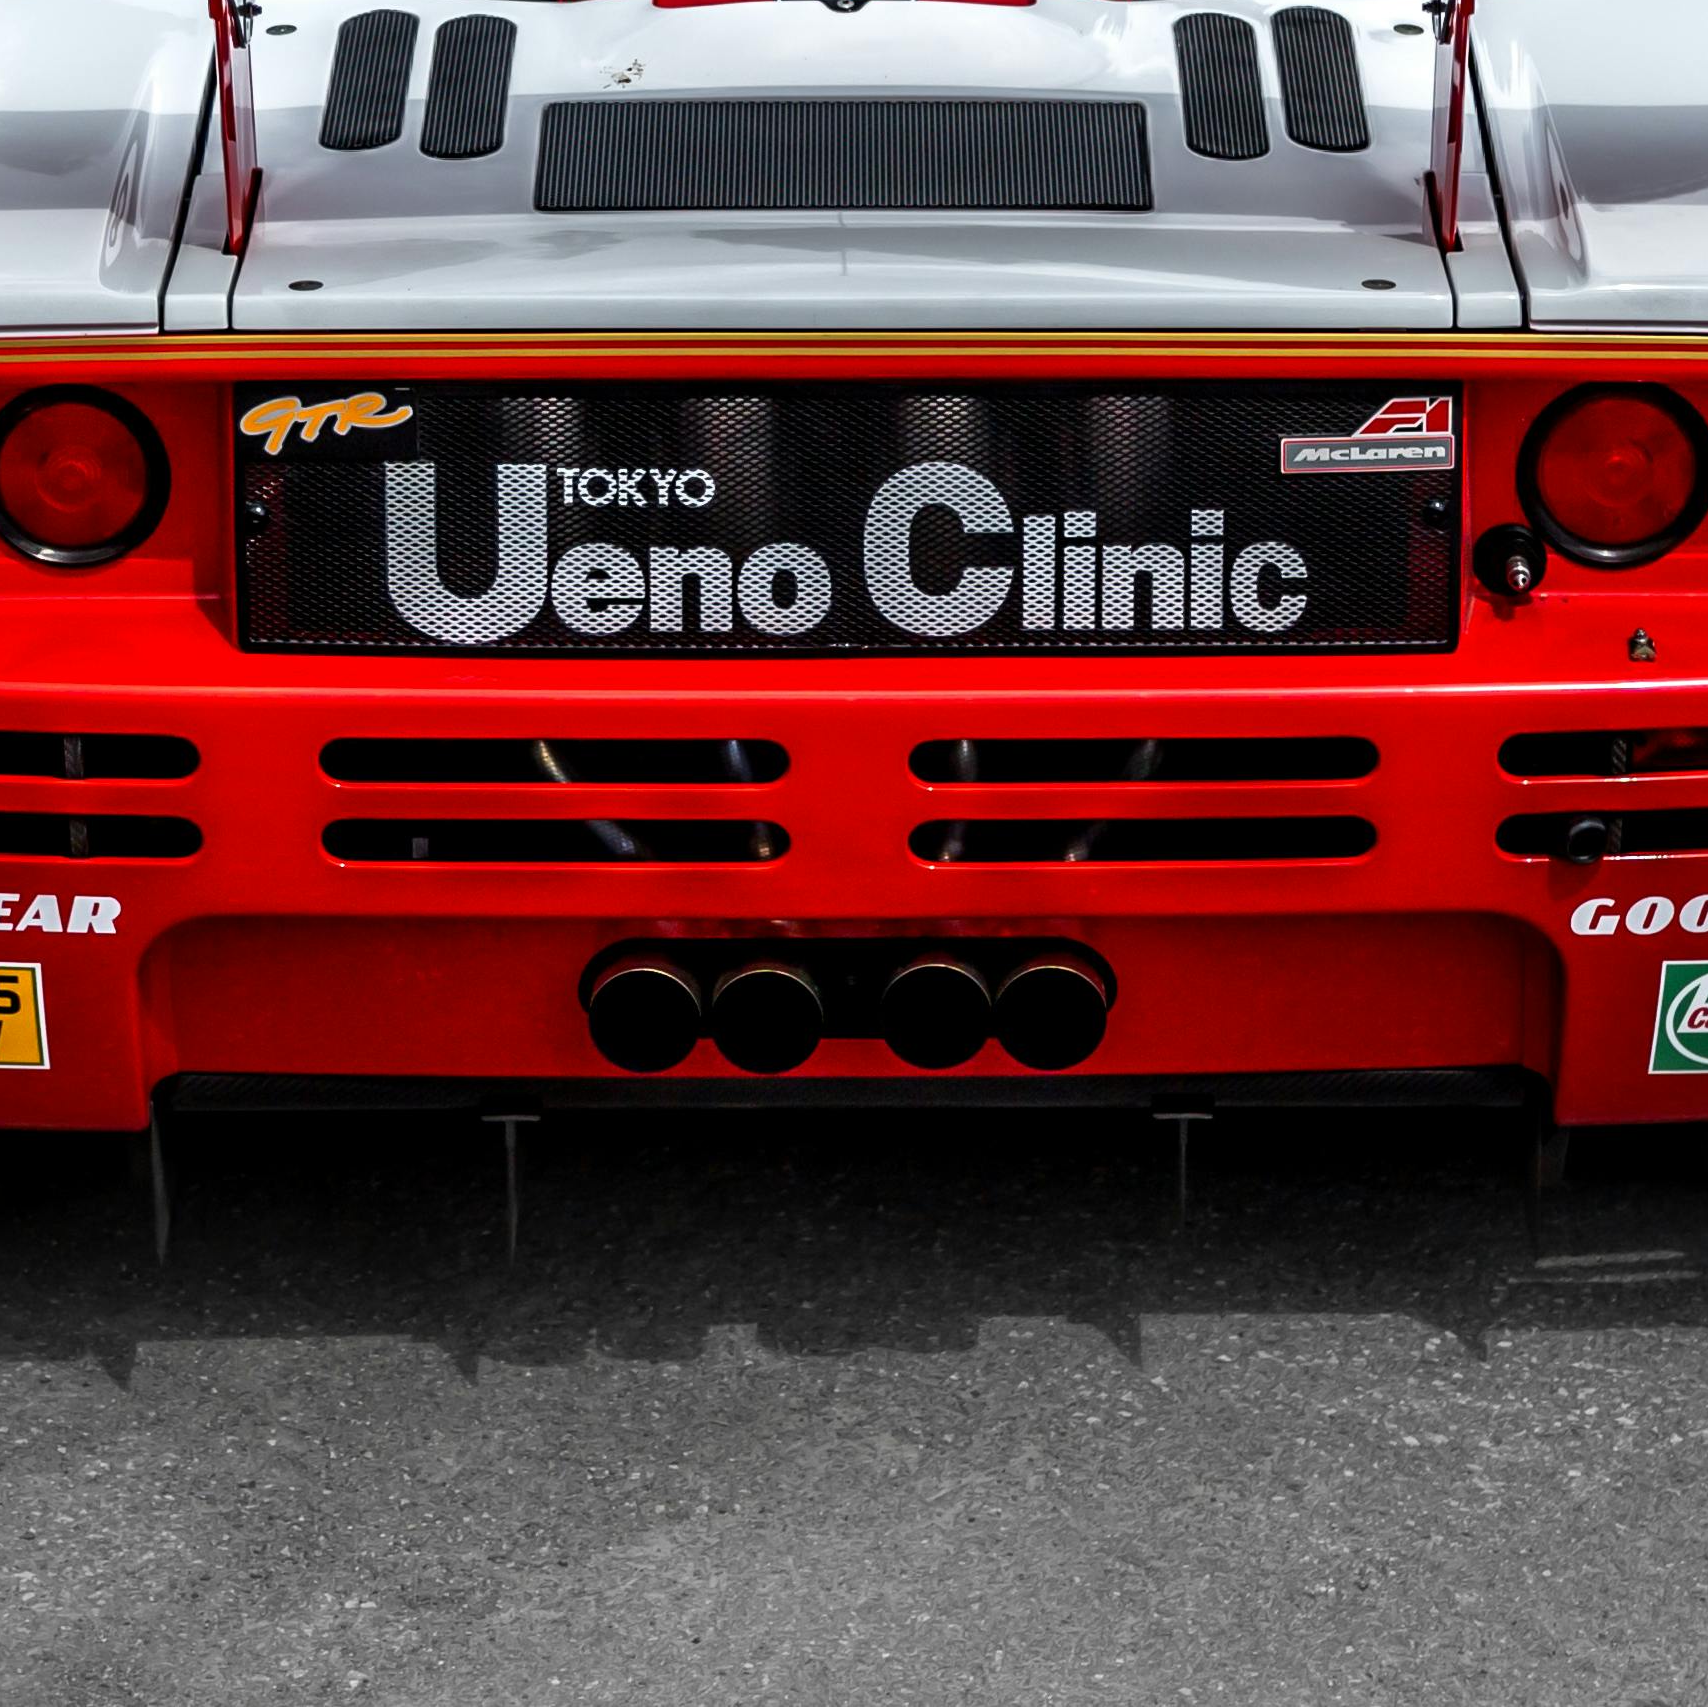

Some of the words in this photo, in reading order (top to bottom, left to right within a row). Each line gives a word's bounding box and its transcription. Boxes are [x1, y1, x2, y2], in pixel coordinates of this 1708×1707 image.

[241, 393, 412, 454] GTR
[1293, 444, 1446, 461] McLaren
[557, 468, 715, 507] TOKYO
[384, 461, 831, 644] Ueno
[863, 461, 1308, 637] Clinic
